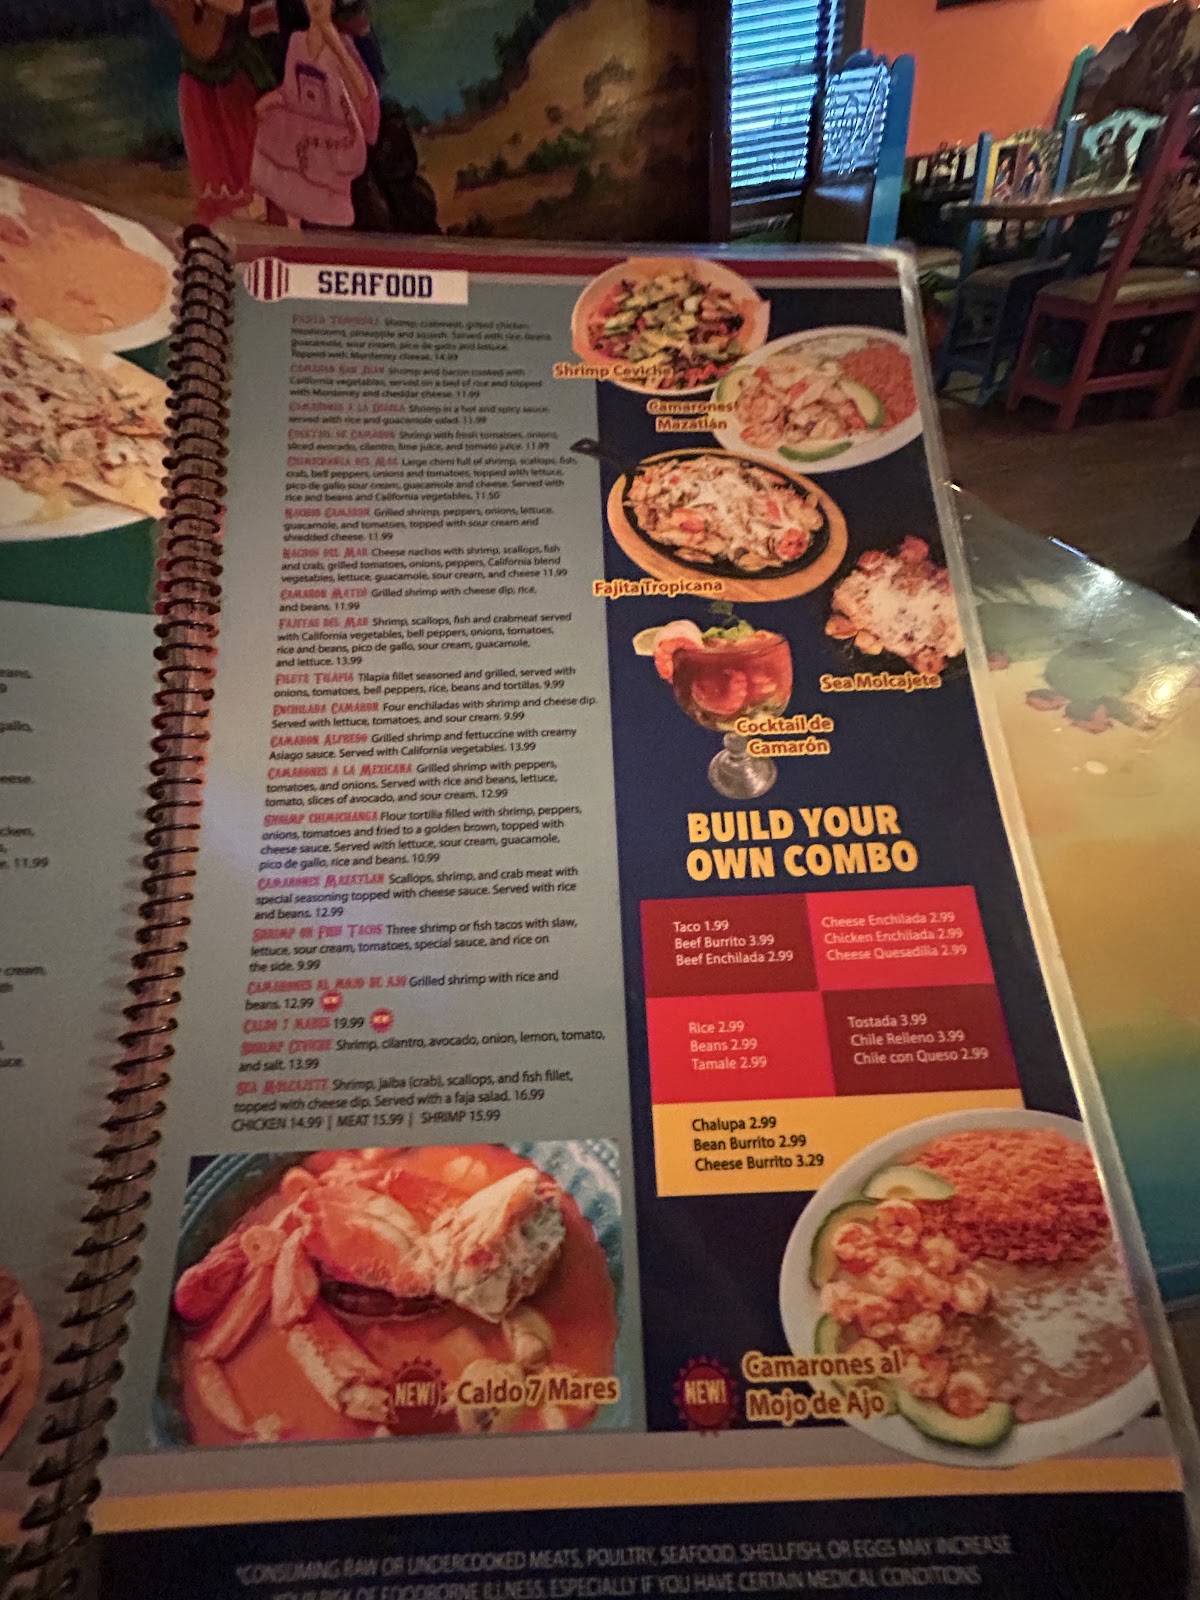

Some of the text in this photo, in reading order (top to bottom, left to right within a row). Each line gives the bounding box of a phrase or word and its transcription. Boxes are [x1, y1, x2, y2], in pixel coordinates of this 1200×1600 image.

[318, 271, 432, 297] SEAFOOD
[555, 364, 672, 381] Shrimp Ceviche
[650, 401, 735, 413] Camarones
[595, 580, 722, 595] Fajita Tropicana
[821, 673, 940, 689] Sea Molcajete
[736, 717, 832, 733] Cocktail de
[749, 738, 828, 754] Camarón
[688, 806, 900, 842] BUILD YOUR
[687, 842, 918, 879] OWN COMBO
[673, 920, 728, 932] Taco 1.99
[821, 912, 955, 927] Cheese Enchilada 2.99
[674, 934, 774, 948] Beef Burrito 3.99
[824, 927, 963, 943] Chicken Enchilada 2.99
[676, 950, 793, 965] Beef Enchilada 2.99
[826, 948, 871, 960] Cheese
[941, 944, 967, 955] 2.99
[688, 1020, 744, 1033] Rice 2.99
[847, 1013, 927, 1027] Tostada 3.99
[690, 1038, 757, 1051] Beans 2.99
[850, 1030, 964, 1045] Chile Relleno 3.99
[692, 1056, 767, 1069] Tamale 2.99
[853, 1047, 988, 1064] Chile con Queso 2.99
[691, 1116, 776, 1132] Chalupa 2.99
[693, 1134, 806, 1150] Bean Burrito 2.99
[695, 1154, 824, 1170] Cheese Burrito 3.29
[746, 1350, 900, 1378] Camarones al
[395, 1384, 440, 1407] NEW!
[457, 1377, 617, 1403] Caldo 7 Mares
[684, 1381, 725, 1402] NEW!
[750, 1389, 885, 1421] Mojo de Ajo
